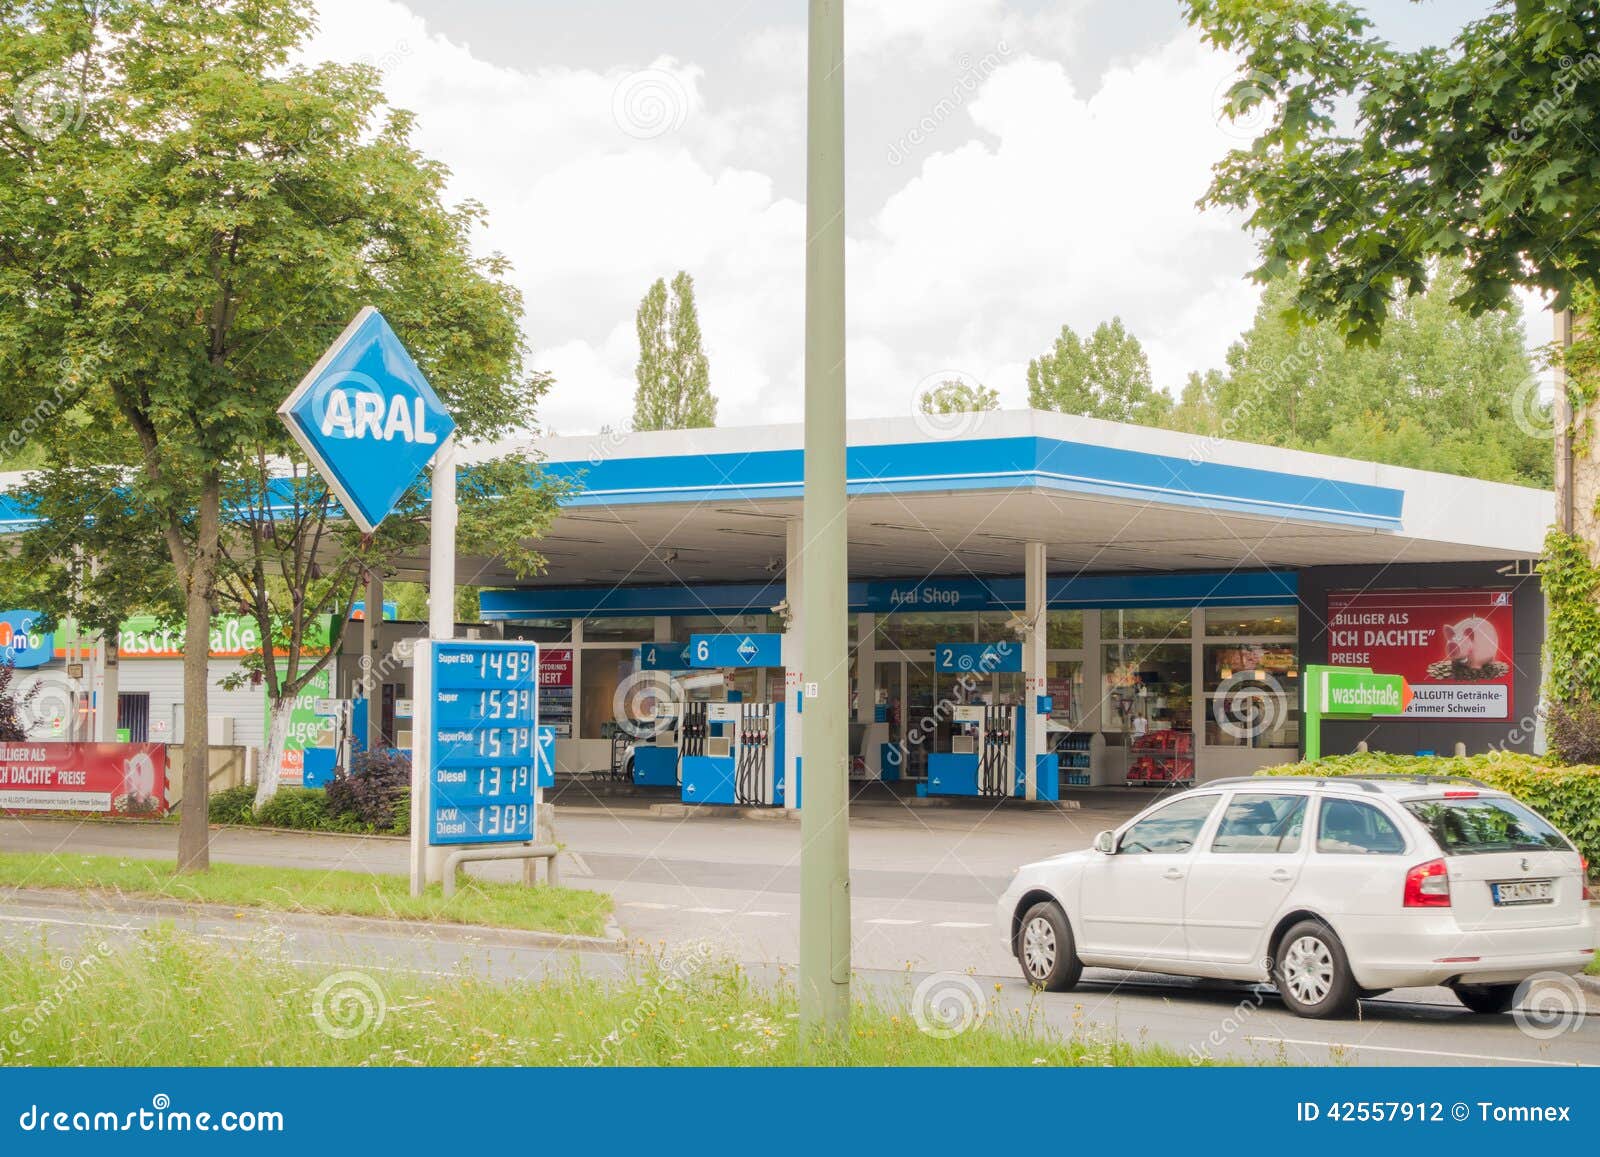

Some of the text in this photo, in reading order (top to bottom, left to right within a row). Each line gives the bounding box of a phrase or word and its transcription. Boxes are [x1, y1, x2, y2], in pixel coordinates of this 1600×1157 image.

[321, 388, 437, 445] ARAL
[890, 588, 960, 606] Aral Shop
[1388, 613, 1409, 625] ALS
[1331, 631, 1359, 647] ICH
[647, 648, 656, 665] 4
[697, 640, 709, 661] 6
[438, 653, 460, 664] Super
[460, 654, 474, 663] E10
[942, 648, 954, 668] 2
[1331, 652, 1370, 664] PREISE
[438, 692, 459, 702] Super
[1332, 683, 1400, 706] waschstraße
[1413, 689, 1503, 701] ALLGUTH Getränke-
[1415, 704, 1445, 713] immer
[1447, 703, 1486, 713] Schwein
[31, 748, 46, 761] ALS
[58, 771, 86, 785] PREISE
[437, 770, 467, 783] Diesel
[436, 809, 457, 820] LKW
[436, 821, 466, 834] Diesel
